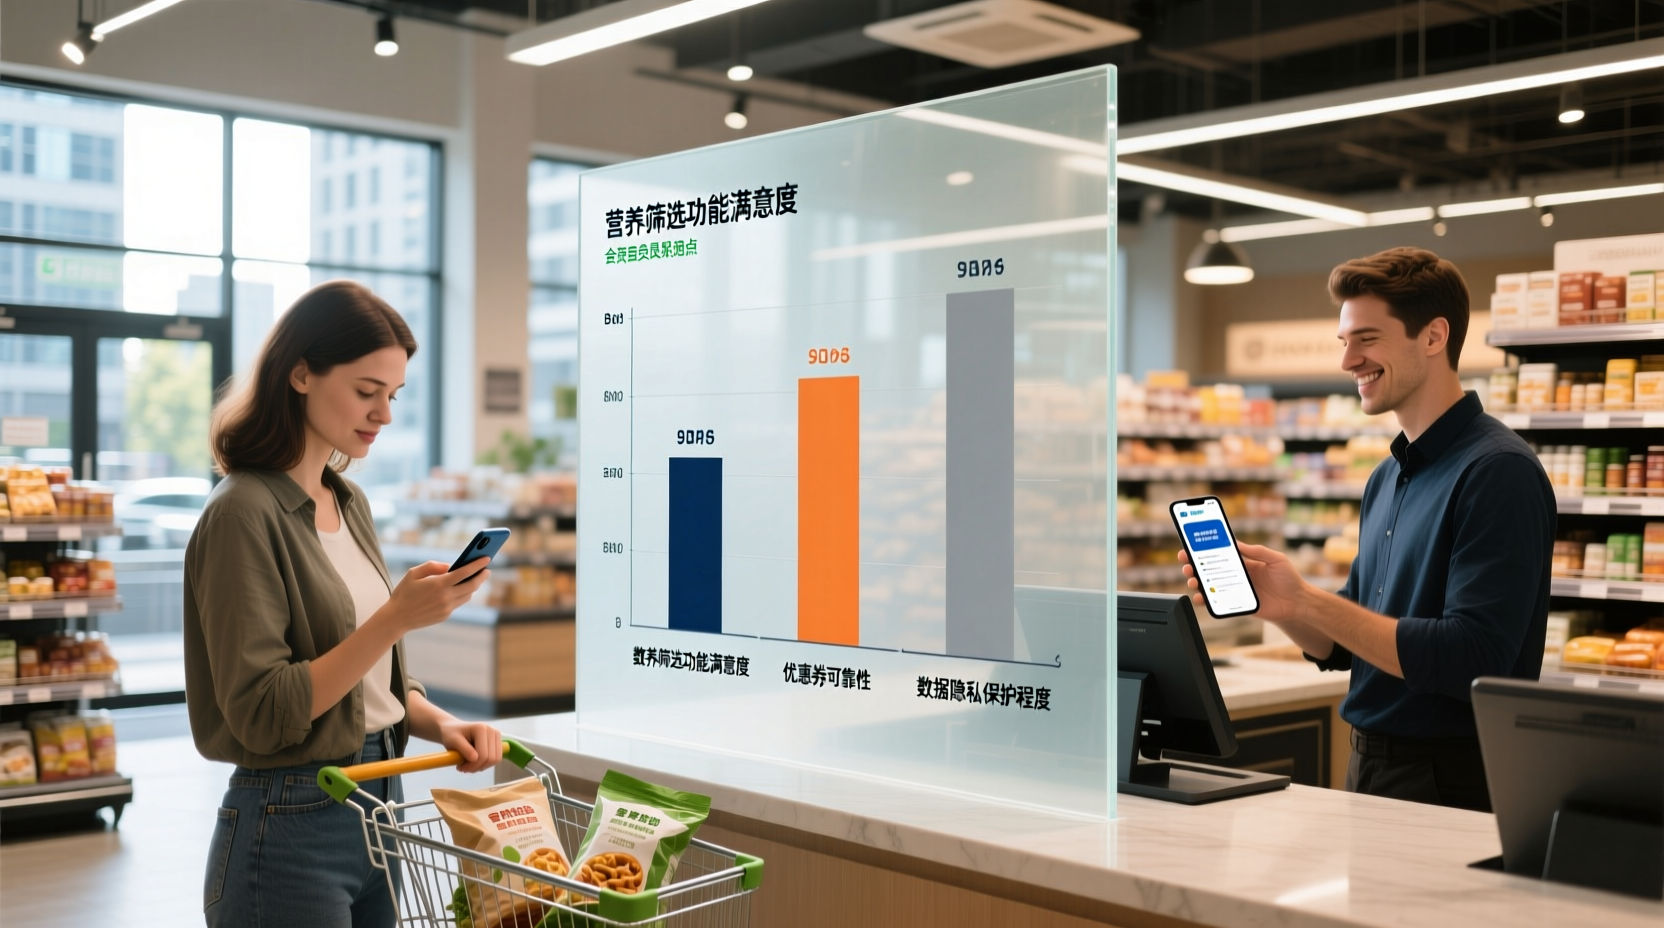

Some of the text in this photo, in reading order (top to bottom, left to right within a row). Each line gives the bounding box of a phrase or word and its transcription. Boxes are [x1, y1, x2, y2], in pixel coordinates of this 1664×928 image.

[605, 182, 799, 239] 营养筛选功能满意度
[783, 661, 871, 690] 优惠券可靠性
[916, 675, 1051, 711] 数据隐私保护程度
